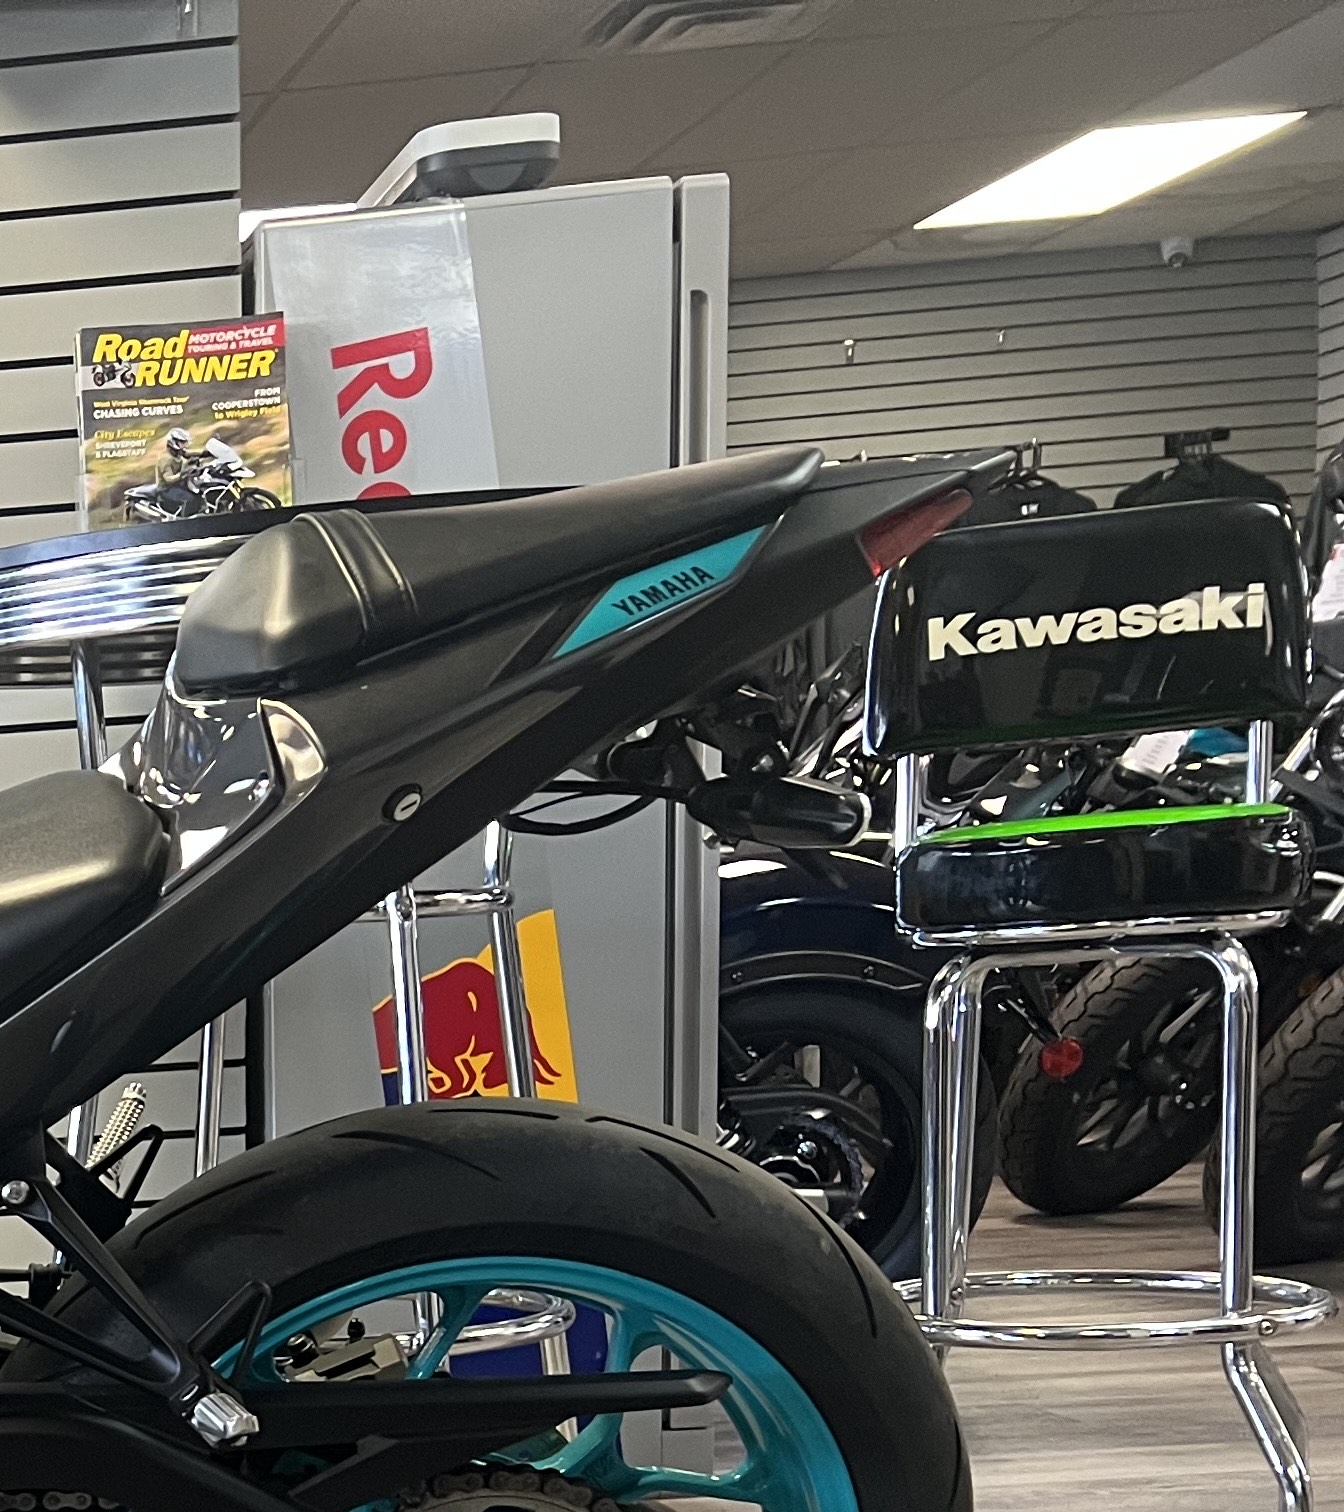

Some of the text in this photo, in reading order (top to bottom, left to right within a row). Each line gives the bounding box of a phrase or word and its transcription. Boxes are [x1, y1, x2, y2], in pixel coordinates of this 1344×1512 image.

[92, 329, 189, 363] Road
[188, 324, 277, 345] MOTORCYCLE
[135, 349, 276, 387] RUNNER
[254, 387, 281, 397] FROM
[93, 405, 184, 419] CHASING CURVES
[611, 566, 714, 616] YAMAHA
[927, 582, 1265, 661] Kawasaki
